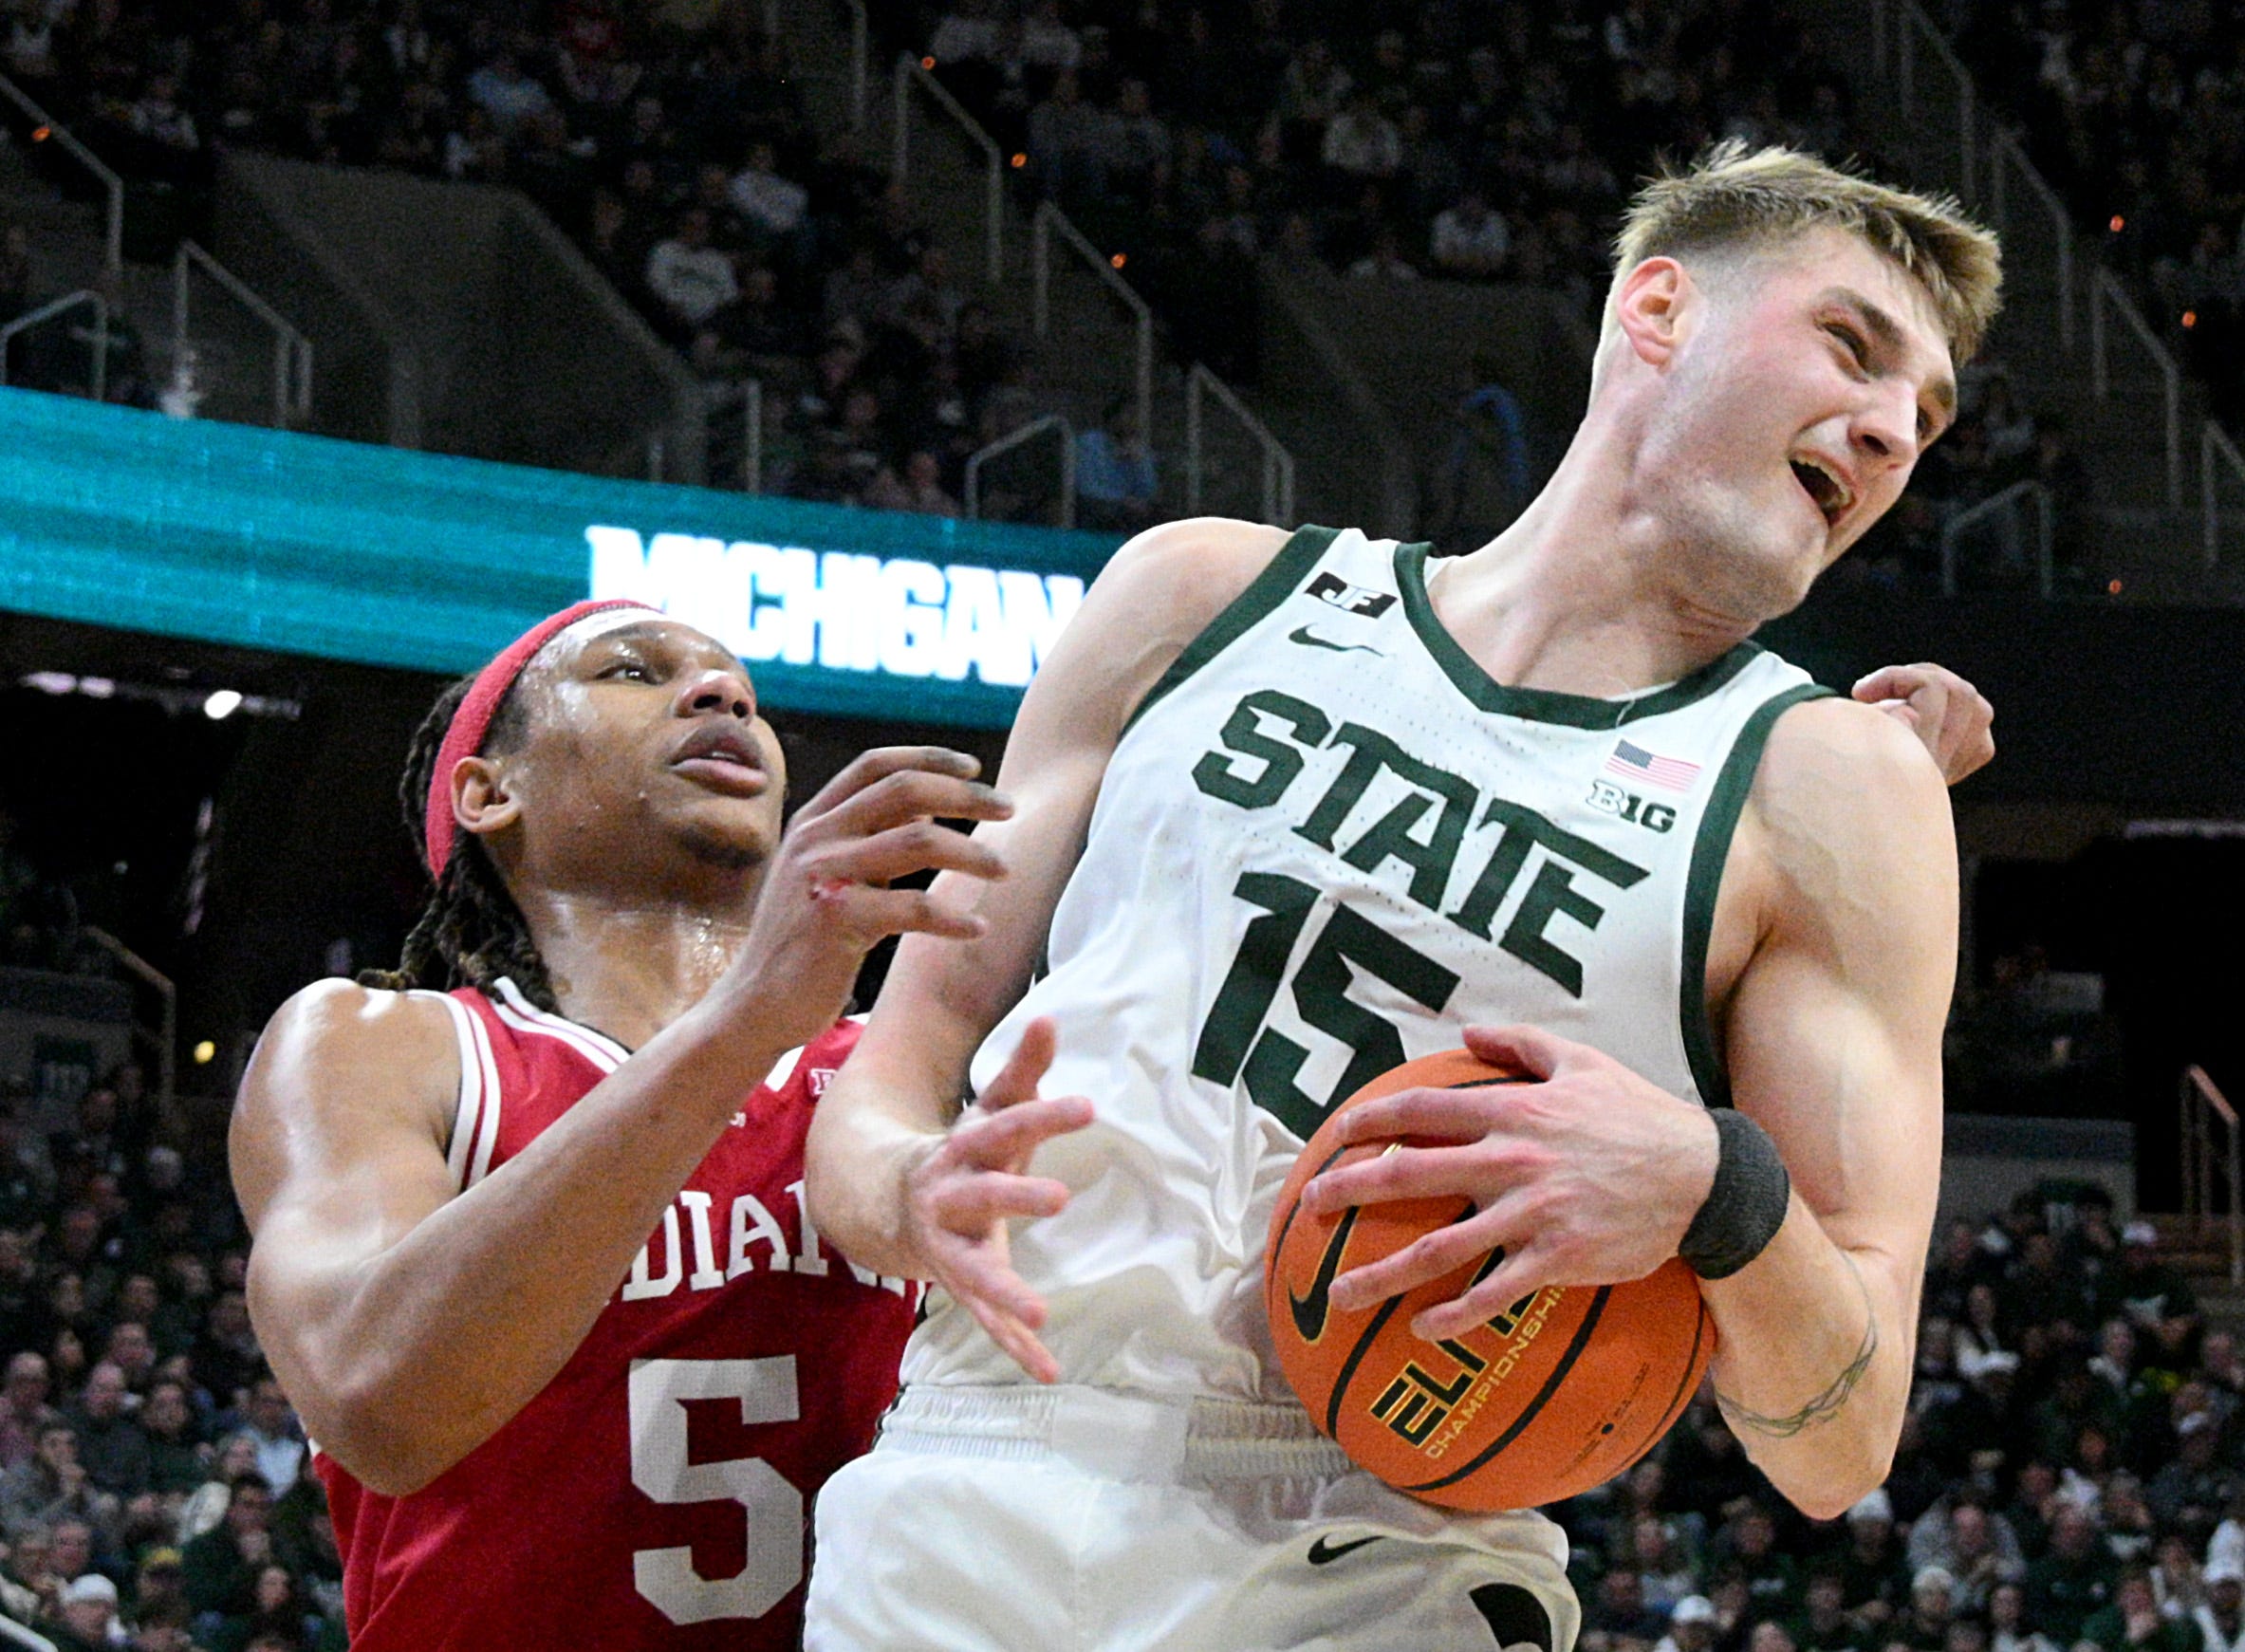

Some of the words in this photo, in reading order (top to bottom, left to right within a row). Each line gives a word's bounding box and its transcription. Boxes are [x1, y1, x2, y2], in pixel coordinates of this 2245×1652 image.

[585, 525, 1085, 686] MICHIGAN
[1192, 690, 1651, 999] STATE
[1191, 871, 1461, 1143] 15
[628, 1354, 804, 1625] 5
[1425, 1287, 1566, 1458] CHAMPIONSHI
